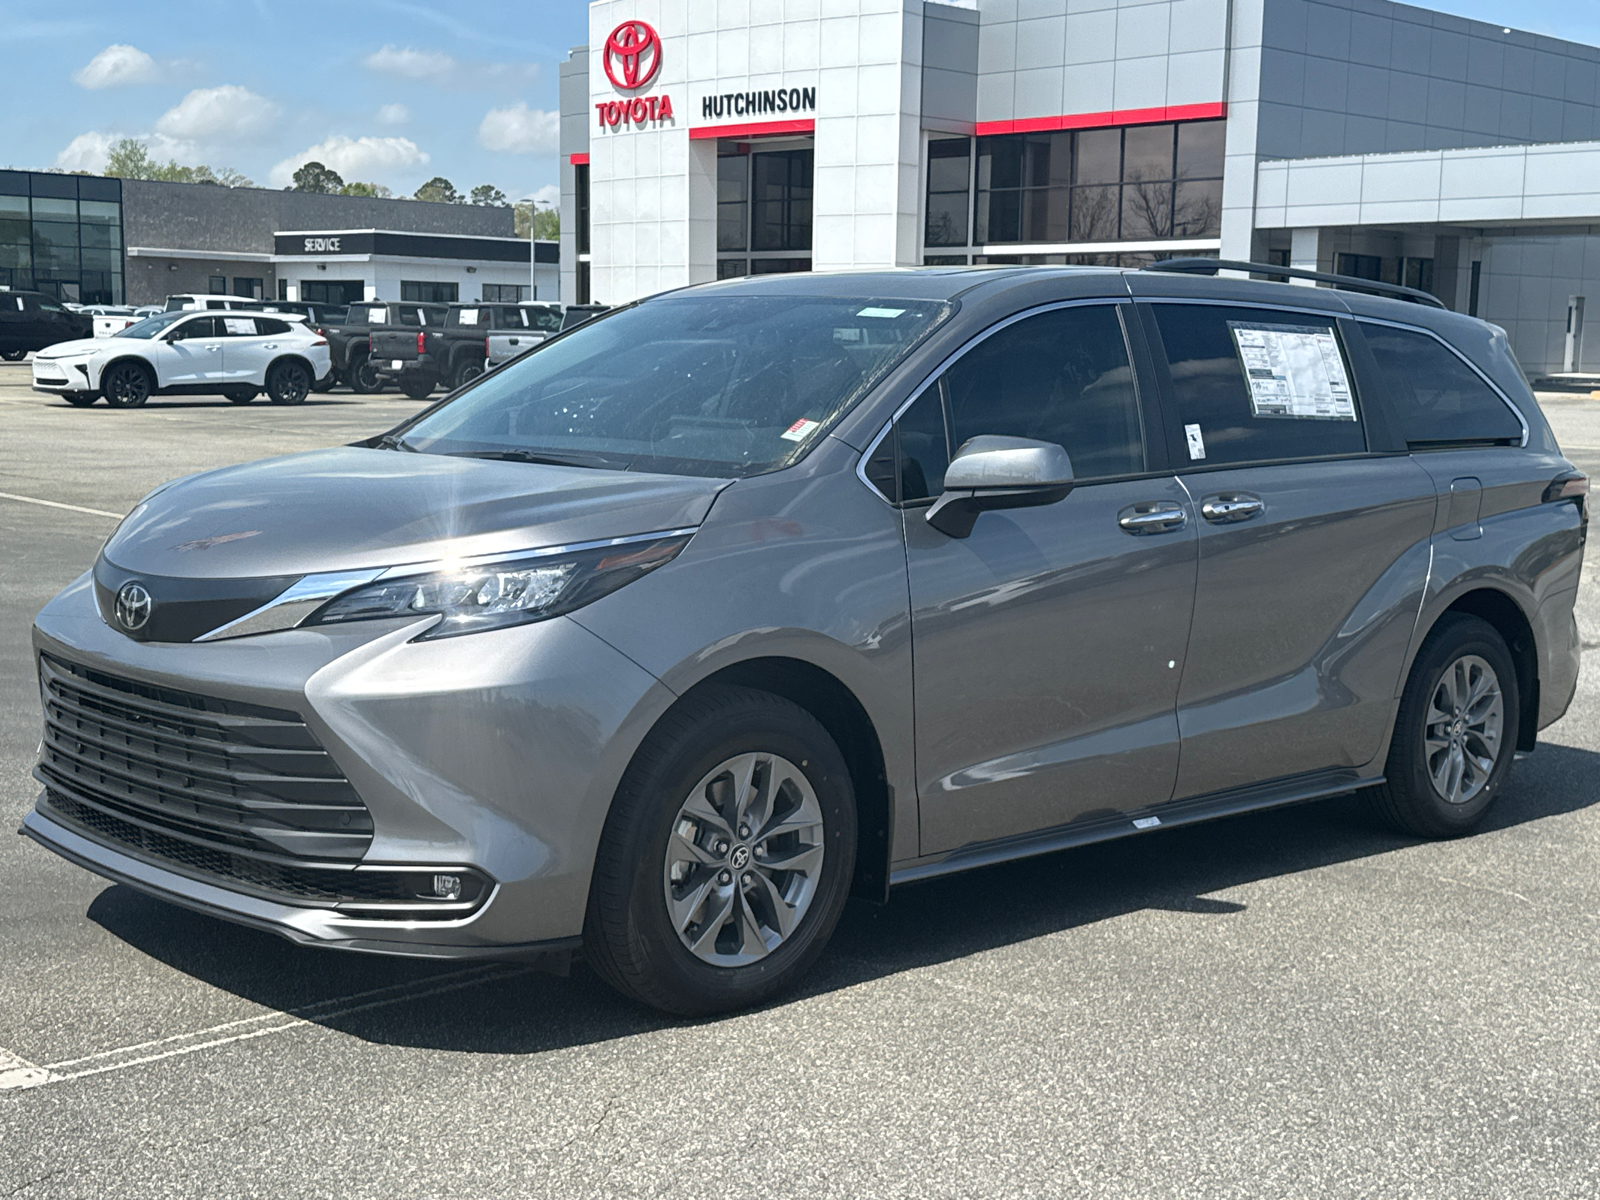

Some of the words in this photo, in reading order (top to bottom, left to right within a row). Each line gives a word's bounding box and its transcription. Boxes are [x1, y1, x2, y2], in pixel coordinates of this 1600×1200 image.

[595, 95, 673, 128] TOYOTA
[702, 87, 816, 117] HUTCHINSON
[304, 238, 341, 252] SERVICE
